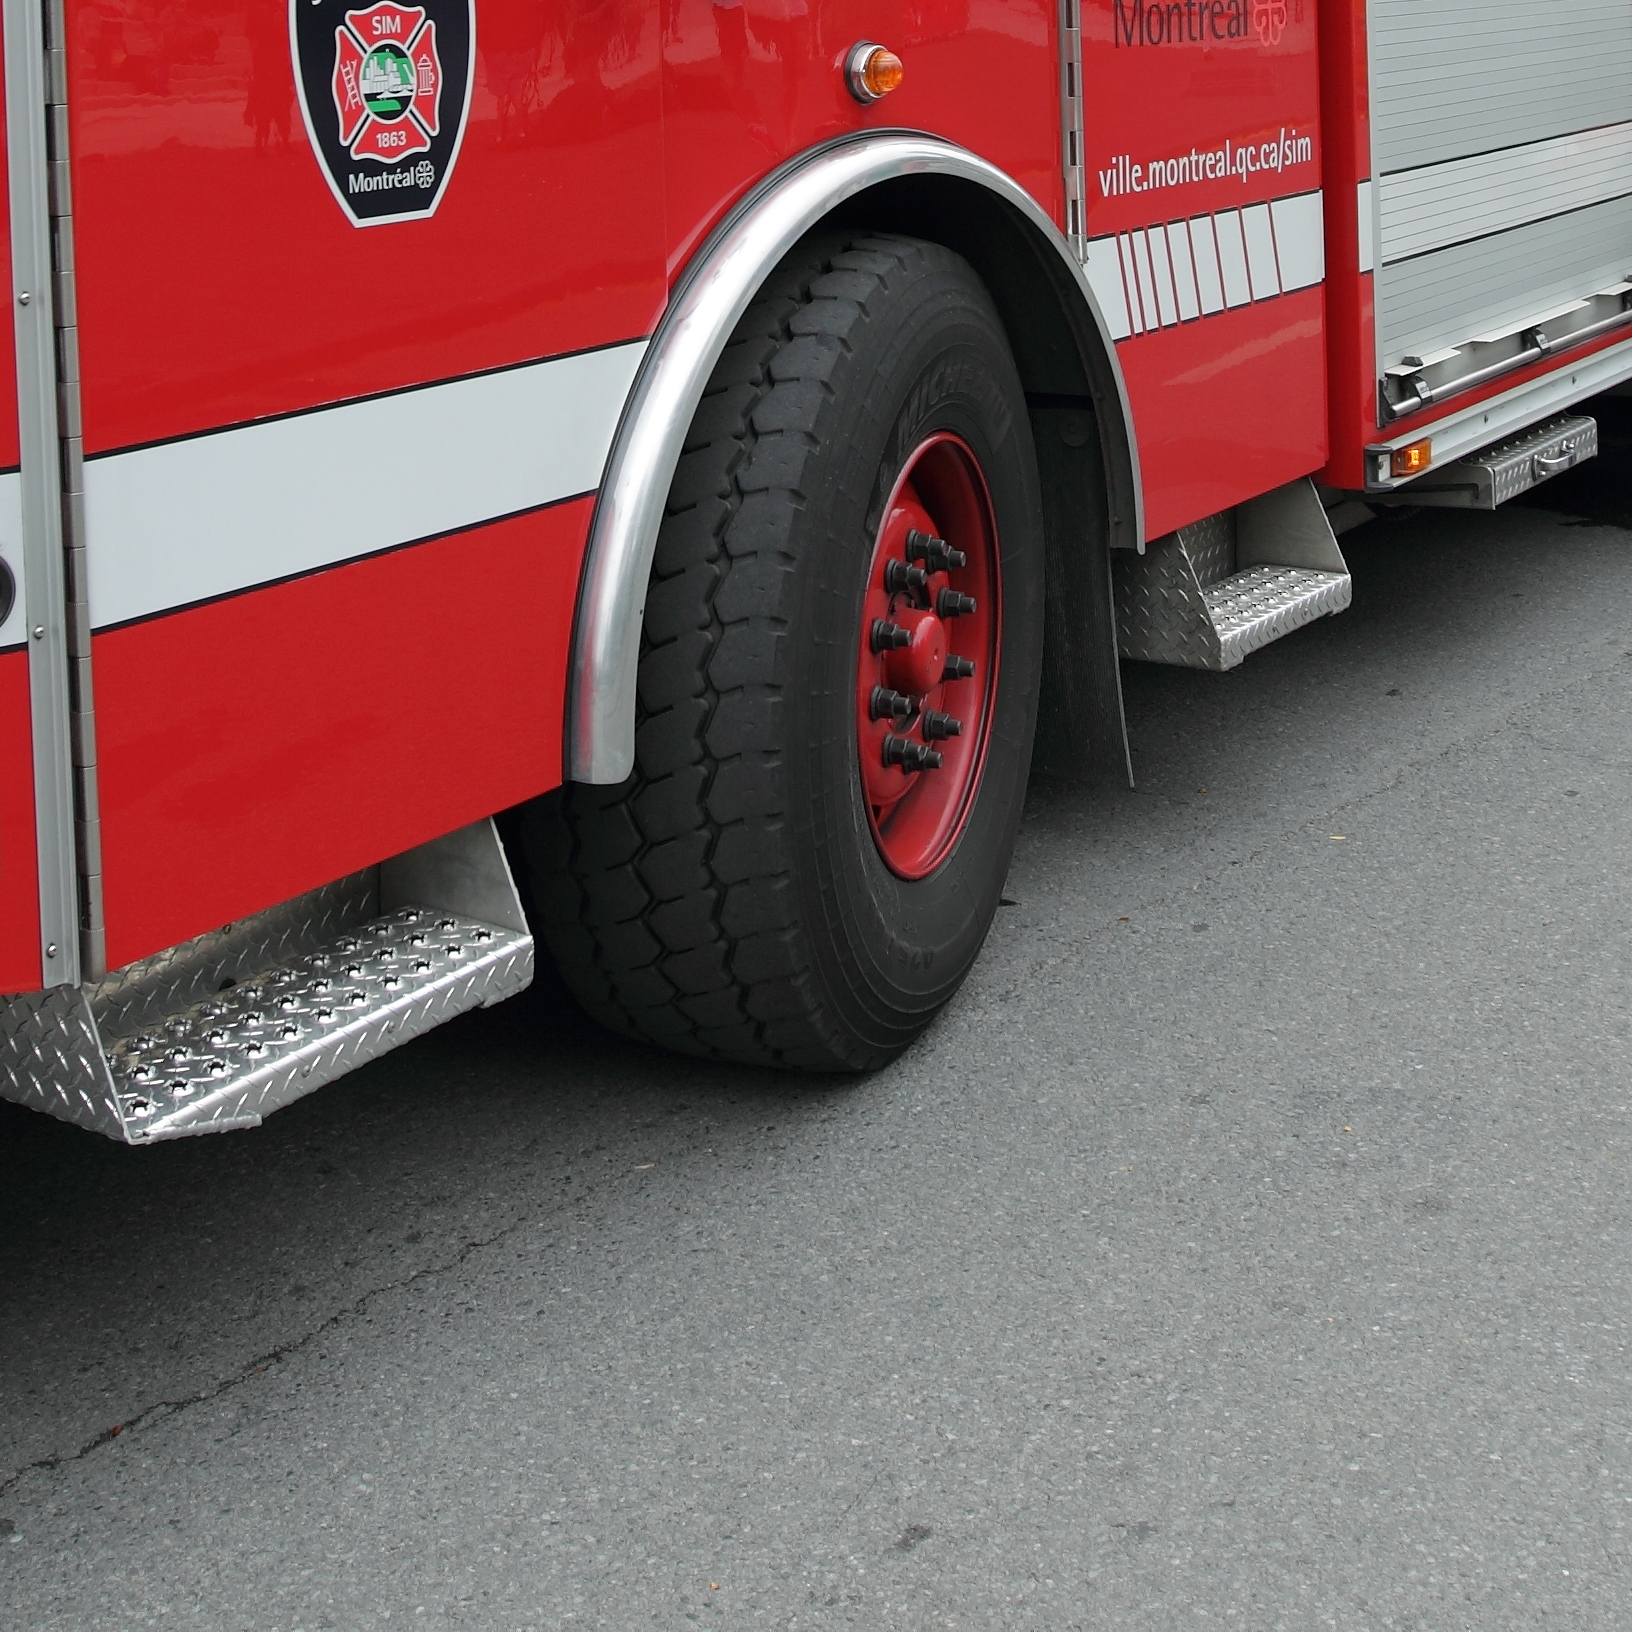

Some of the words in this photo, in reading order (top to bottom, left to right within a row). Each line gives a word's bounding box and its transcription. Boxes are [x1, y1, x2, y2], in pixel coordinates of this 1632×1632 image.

[371, 14, 402, 36] SIM
[375, 130, 407, 149] 1863
[1099, 127, 1312, 198] ville.montreal.qc.ca/sim
[348, 166, 415, 194] Montréal
